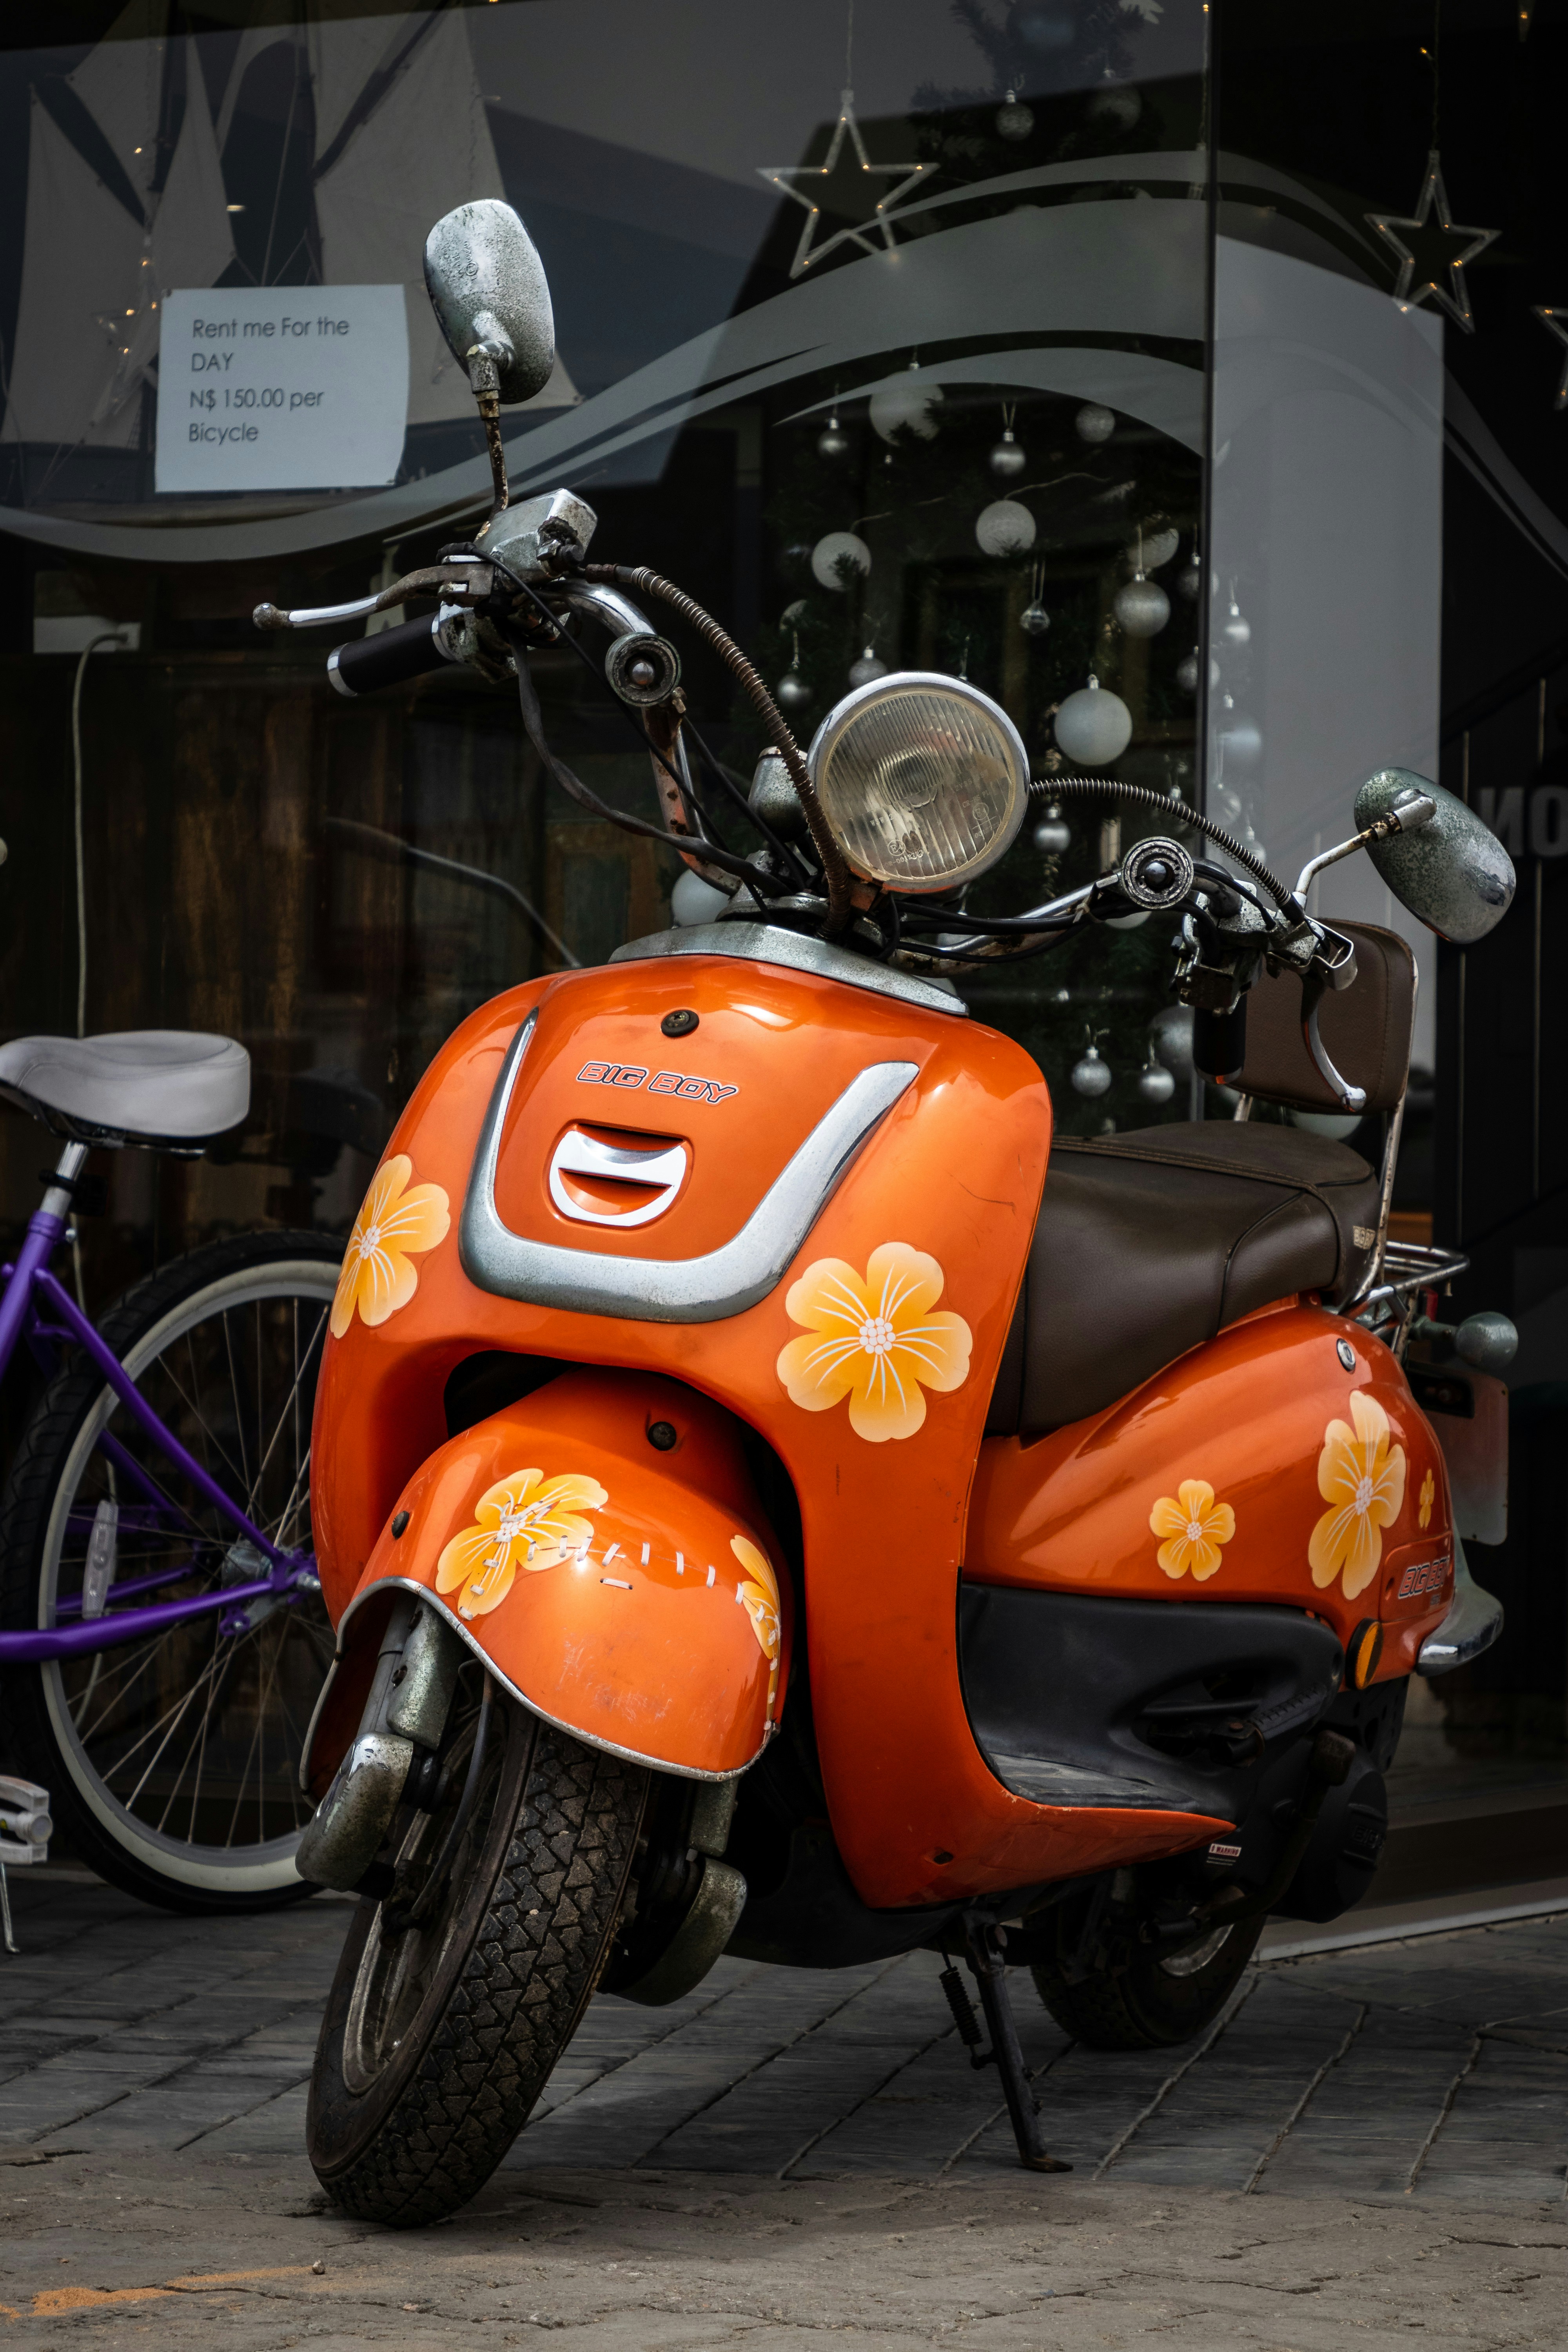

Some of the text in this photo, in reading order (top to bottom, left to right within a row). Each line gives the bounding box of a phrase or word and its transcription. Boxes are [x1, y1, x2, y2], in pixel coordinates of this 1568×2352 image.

[193, 317, 349, 338] Rent me For the
[192, 353, 234, 372] DAY
[190, 388, 324, 411] N$ 150.00 per
[189, 423, 259, 445] Bicycle
[576, 1061, 739, 1104] BIG BOY
[1398, 1563, 1430, 1599] BIG
